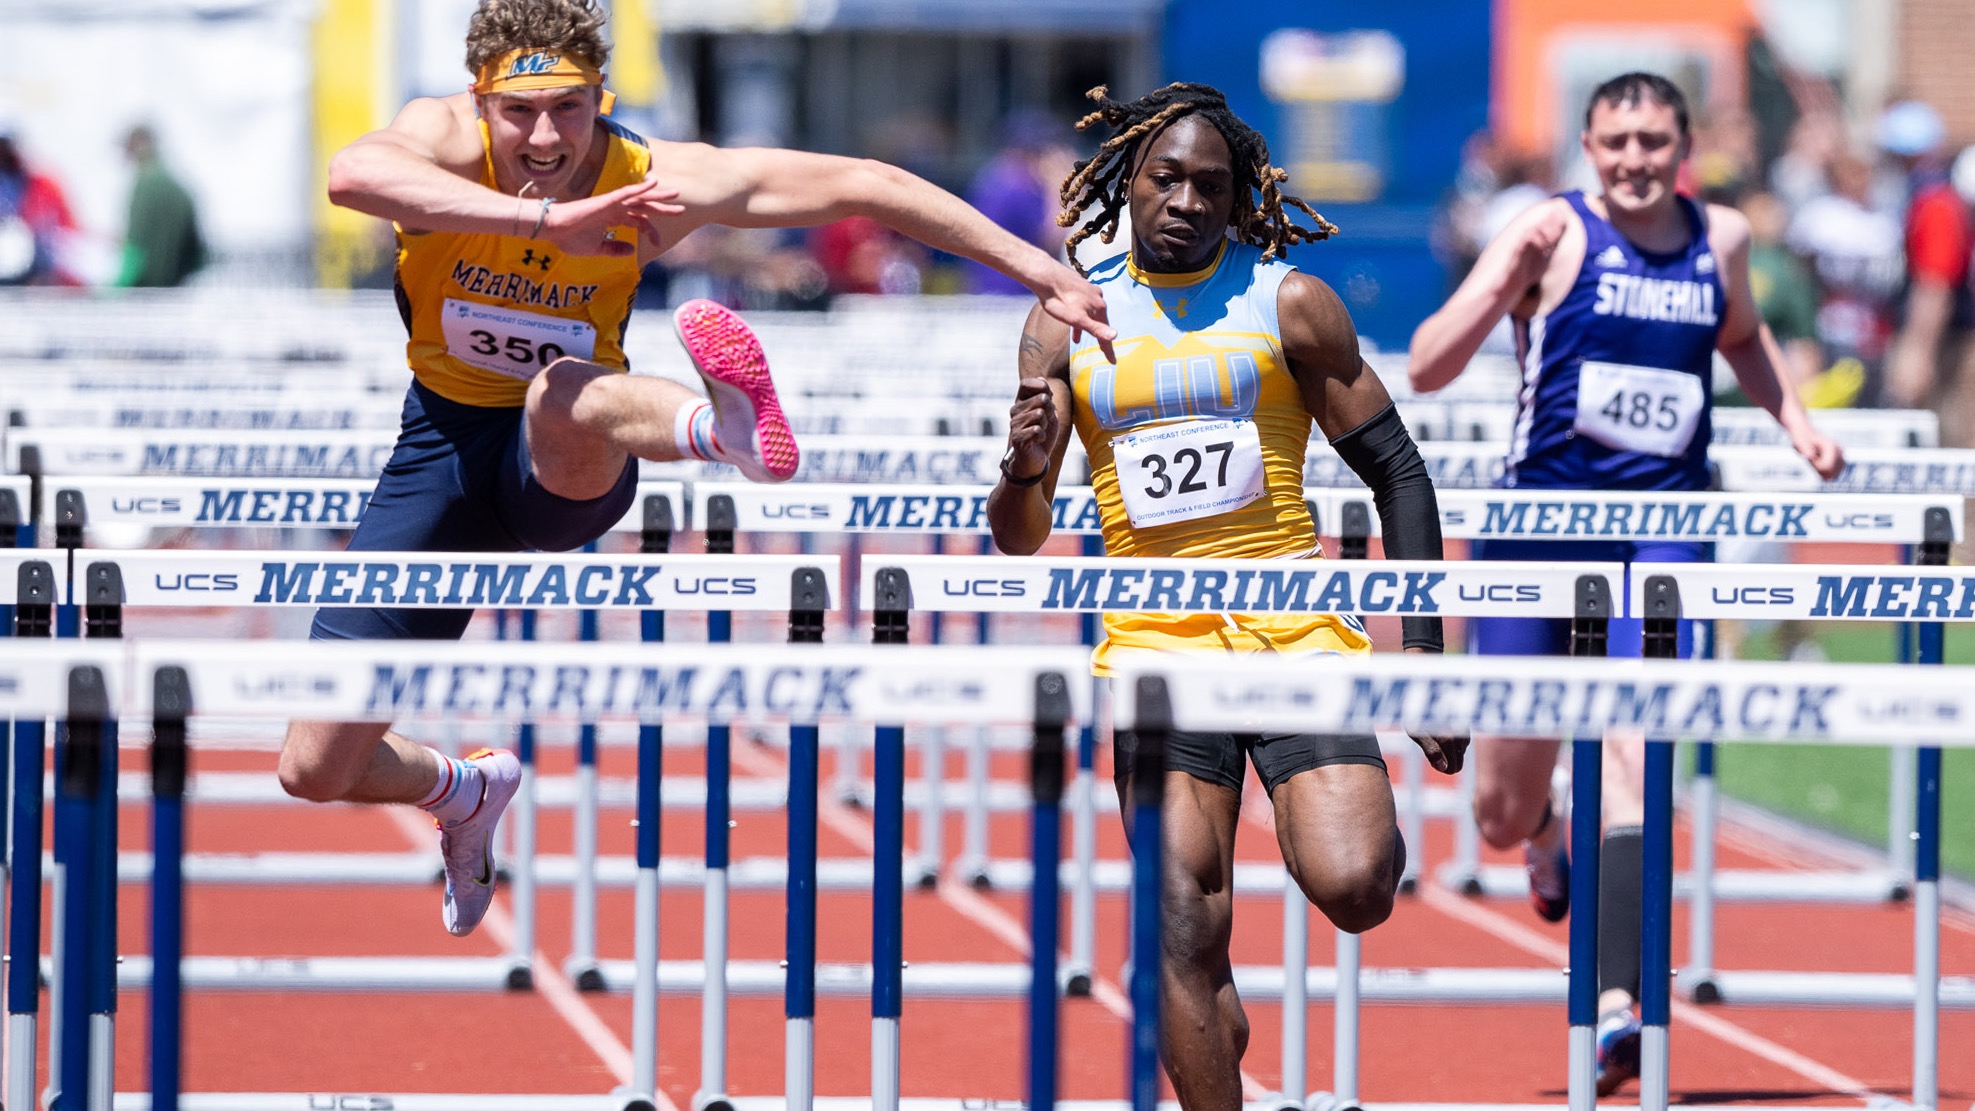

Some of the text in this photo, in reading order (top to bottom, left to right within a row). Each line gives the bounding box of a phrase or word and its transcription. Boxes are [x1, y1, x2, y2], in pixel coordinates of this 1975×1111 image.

[451, 259, 599, 309] MERRIMACK
[1593, 272, 1718, 326] STONEHILL
[472, 311, 568, 333] NORTHEAST CONFERENCE
[469, 329, 565, 367] 350
[1089, 351, 1261, 430] LIU
[1601, 390, 1680, 431] 485
[1139, 422, 1229, 444] NORTHEAST CONFERENCE
[1141, 441, 1234, 499] 327
[112, 498, 181, 513] UCS
[762, 503, 831, 520] UCS
[1136, 512, 1166, 521] OUTDOOR
[1166, 508, 1188, 517] TRACK
[1193, 503, 1211, 511] FIELD
[1478, 502, 1815, 537] MERRIMACK
[1825, 513, 1893, 530] UCS
[155, 562, 756, 606] UCS MERRIMACK UCS
[943, 568, 1542, 613] UCS MERRIMACK UCS
[1711, 586, 1795, 606] UCS
[366, 663, 863, 714] MERRIMACK
[1344, 677, 1842, 733] MERRIMACK
